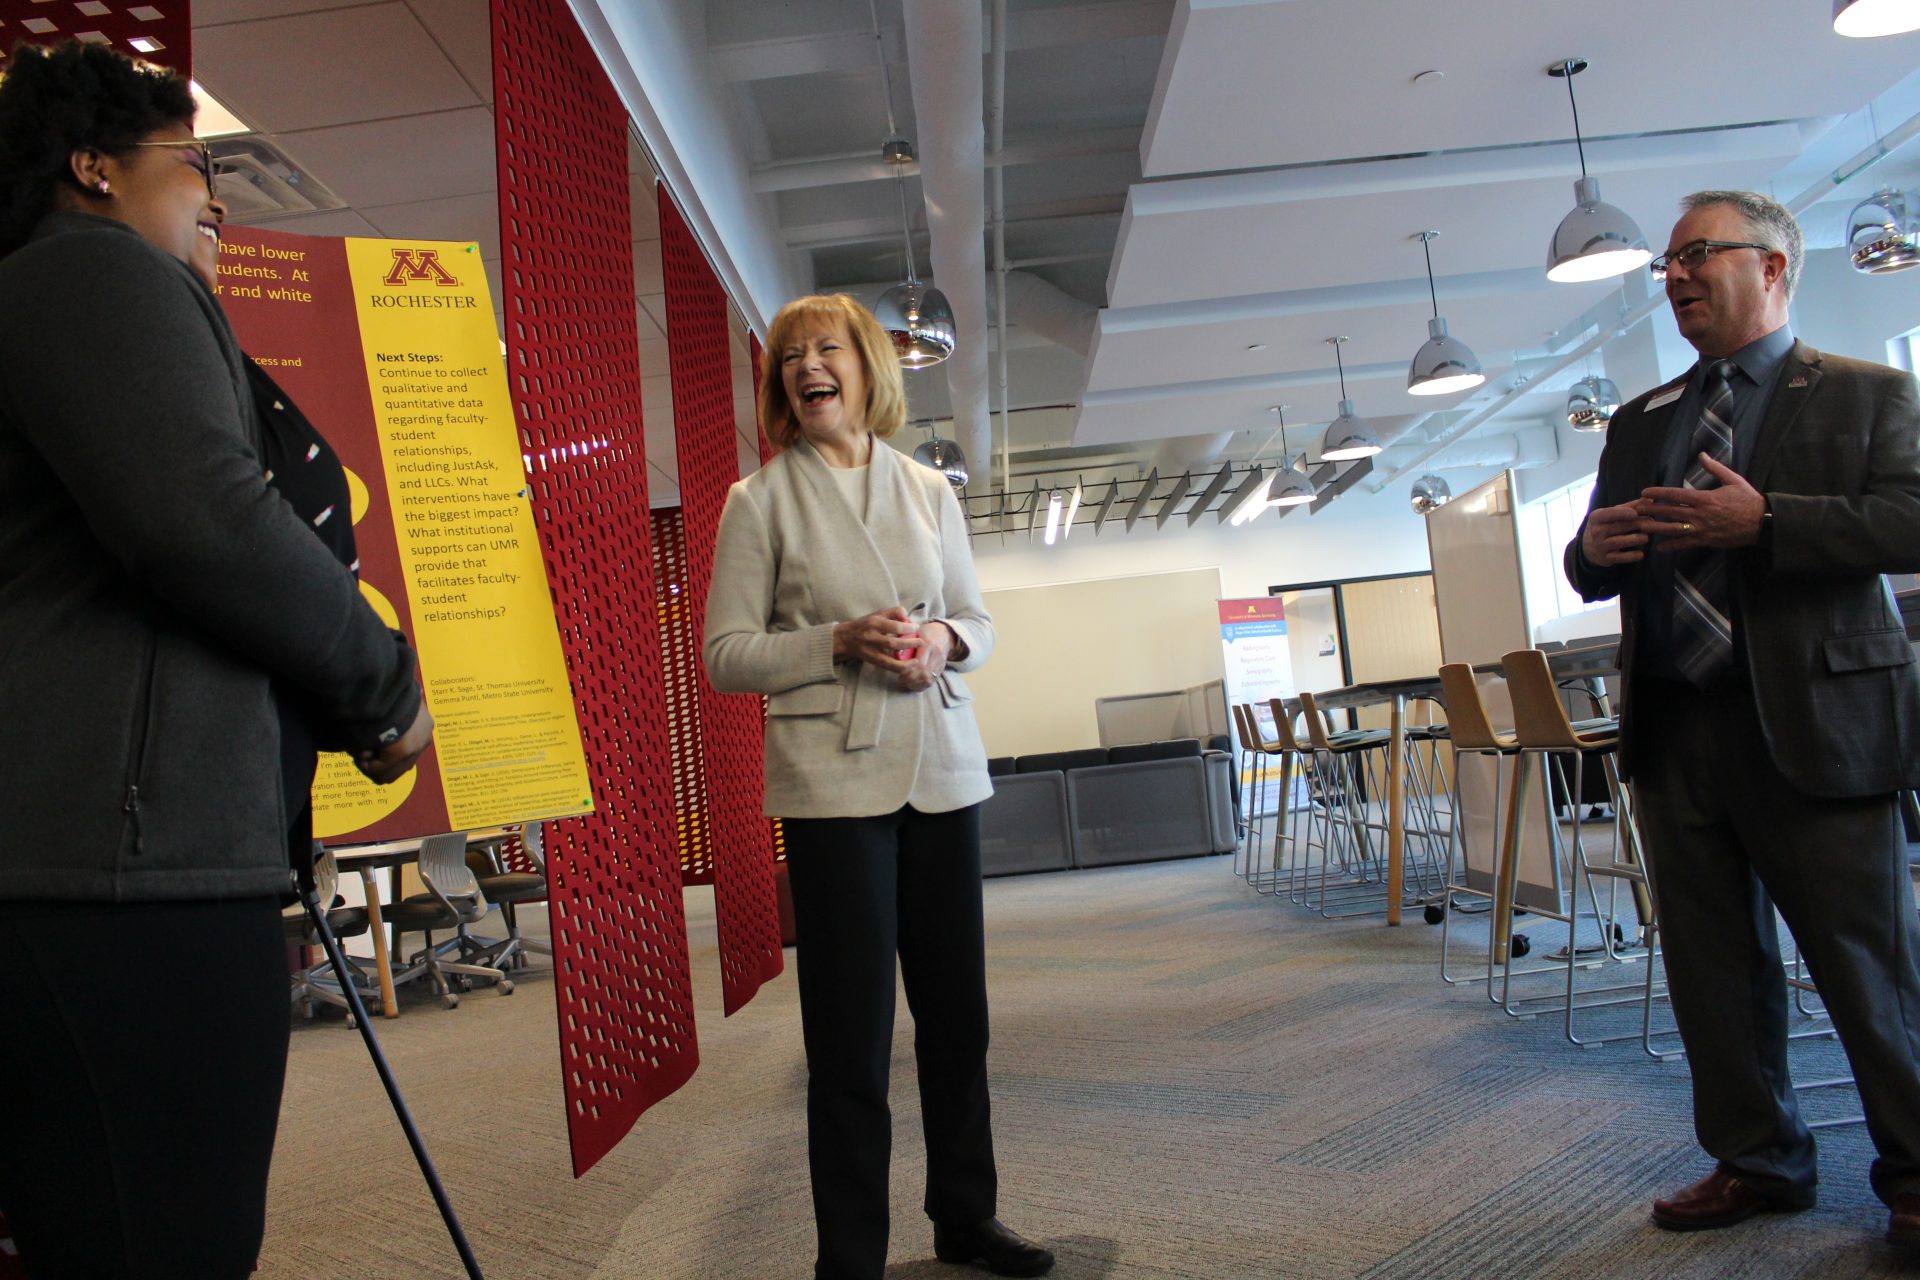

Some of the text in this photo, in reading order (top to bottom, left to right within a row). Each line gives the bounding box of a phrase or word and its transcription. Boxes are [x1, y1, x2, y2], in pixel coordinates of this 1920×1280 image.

[218, 239, 305, 261] have lower
[216, 263, 309, 282] tudents. At
[231, 285, 261, 298] and
[267, 287, 312, 303] white
[371, 295, 478, 308] ROCHESTER
[250, 357, 302, 367] cess and
[376, 352, 444, 364] Next Steps:
[379, 367, 489, 378] Continue to collect
[382, 383, 468, 395] qualitative and
[385, 398, 483, 410] quantitative data
[388, 413, 489, 426] regarding faculty-
[390, 430, 436, 441] student
[393, 445, 472, 457] relationships,
[396, 460, 499, 473] including JustAsk,
[399, 476, 489, 489] and LLCs. What
[402, 491, 510, 505] interventions have
[405, 507, 519, 522] the biggest impact?
[407, 523, 514, 539] What institutional
[411, 539, 519, 556] supports can UMR
[414, 558, 487, 574] provide that
[417, 573, 521, 589] facilitates faculty-
[421, 593, 467, 605] student
[424, 606, 506, 622] relationships?
[486, 682, 512, 690] Thomas
[513, 679, 545, 688] University
[434, 697, 460, 705] Gemma
[482, 692, 502, 700] Metro
[521, 687, 554, 696] University
